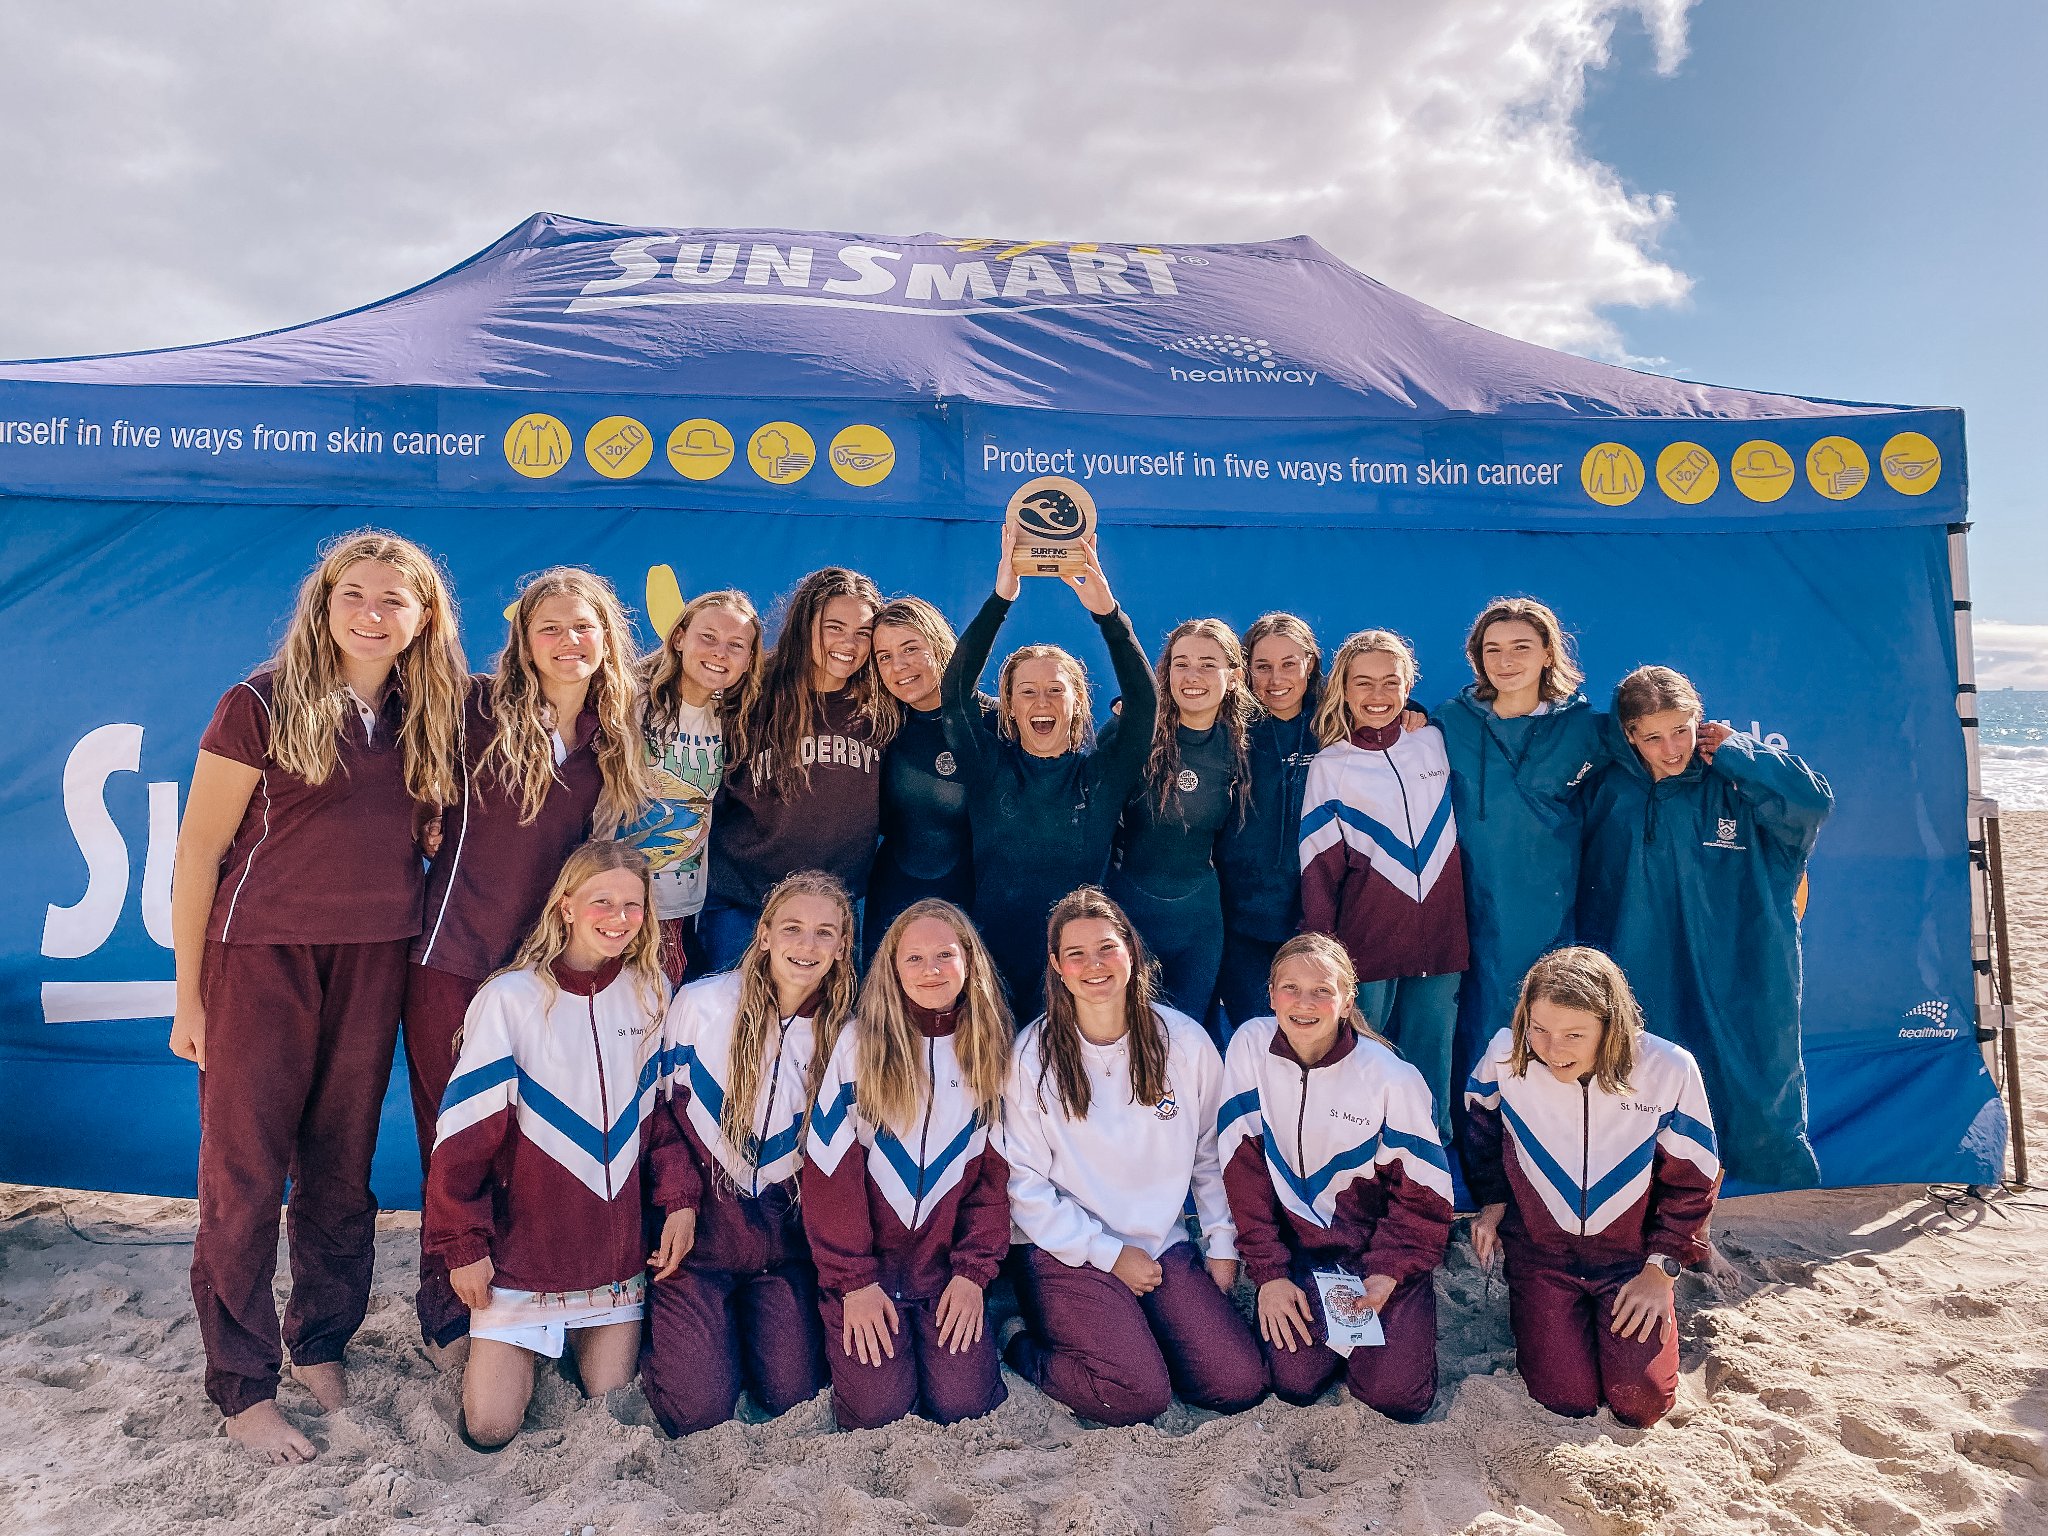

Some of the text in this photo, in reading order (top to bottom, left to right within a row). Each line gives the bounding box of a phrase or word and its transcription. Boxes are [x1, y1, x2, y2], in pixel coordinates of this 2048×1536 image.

[1169, 366, 1318, 386] healthway
[77, 418, 101, 446] in
[112, 419, 161, 448] five
[171, 426, 243, 456] ways
[252, 423, 317, 452] from
[326, 427, 382, 454] skin
[392, 431, 486, 456] cancer
[983, 444, 1563, 487] Protect yourself in five ways from skin cancer
[1030, 547, 1068, 556] SURFING
[1898, 1027, 1959, 1041] healthway
[1329, 1108, 1371, 1126] St Mary's
[1620, 1102, 1662, 1114] St Mary's
